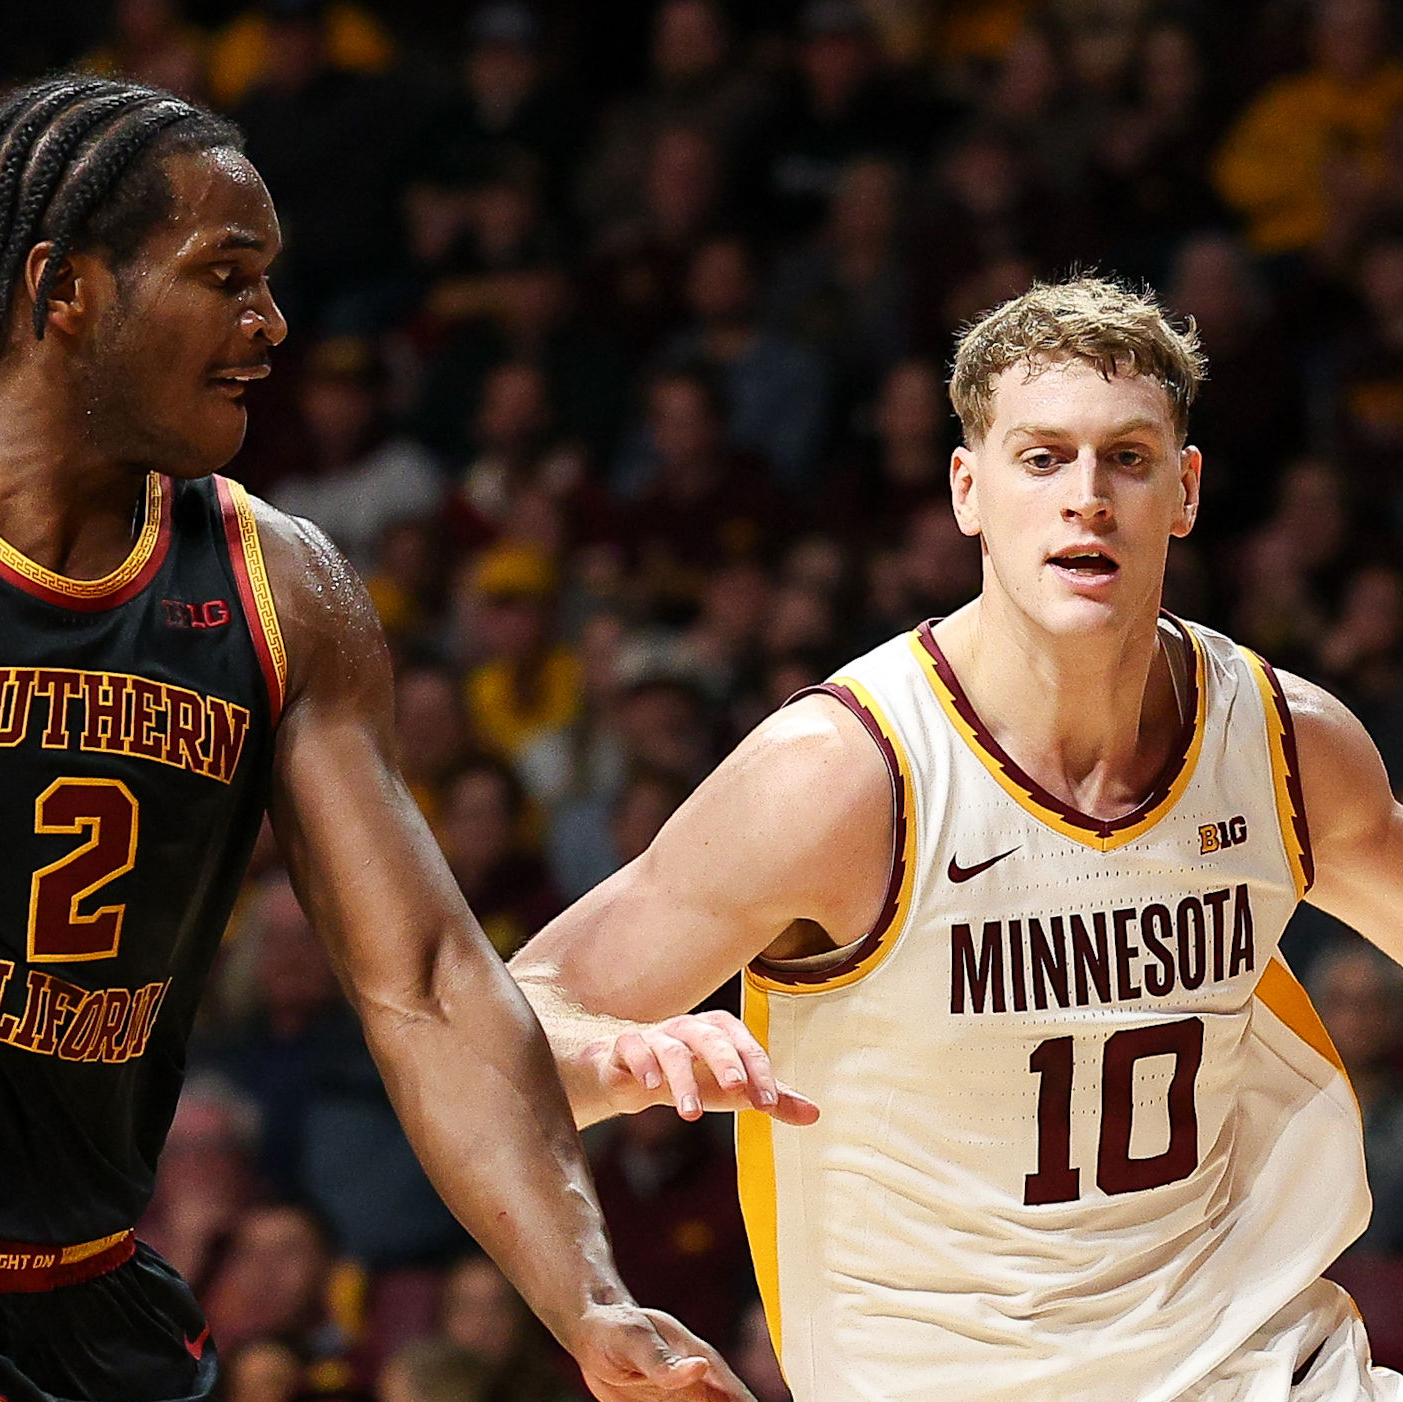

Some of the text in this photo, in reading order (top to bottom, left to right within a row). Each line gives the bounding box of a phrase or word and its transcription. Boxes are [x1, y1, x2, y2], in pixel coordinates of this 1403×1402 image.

[26, 776, 139, 963] 2
[949, 883, 1256, 1016] MINNESOTA
[1022, 1015, 1205, 1207] 10
[32, 1254, 56, 1269] ON
